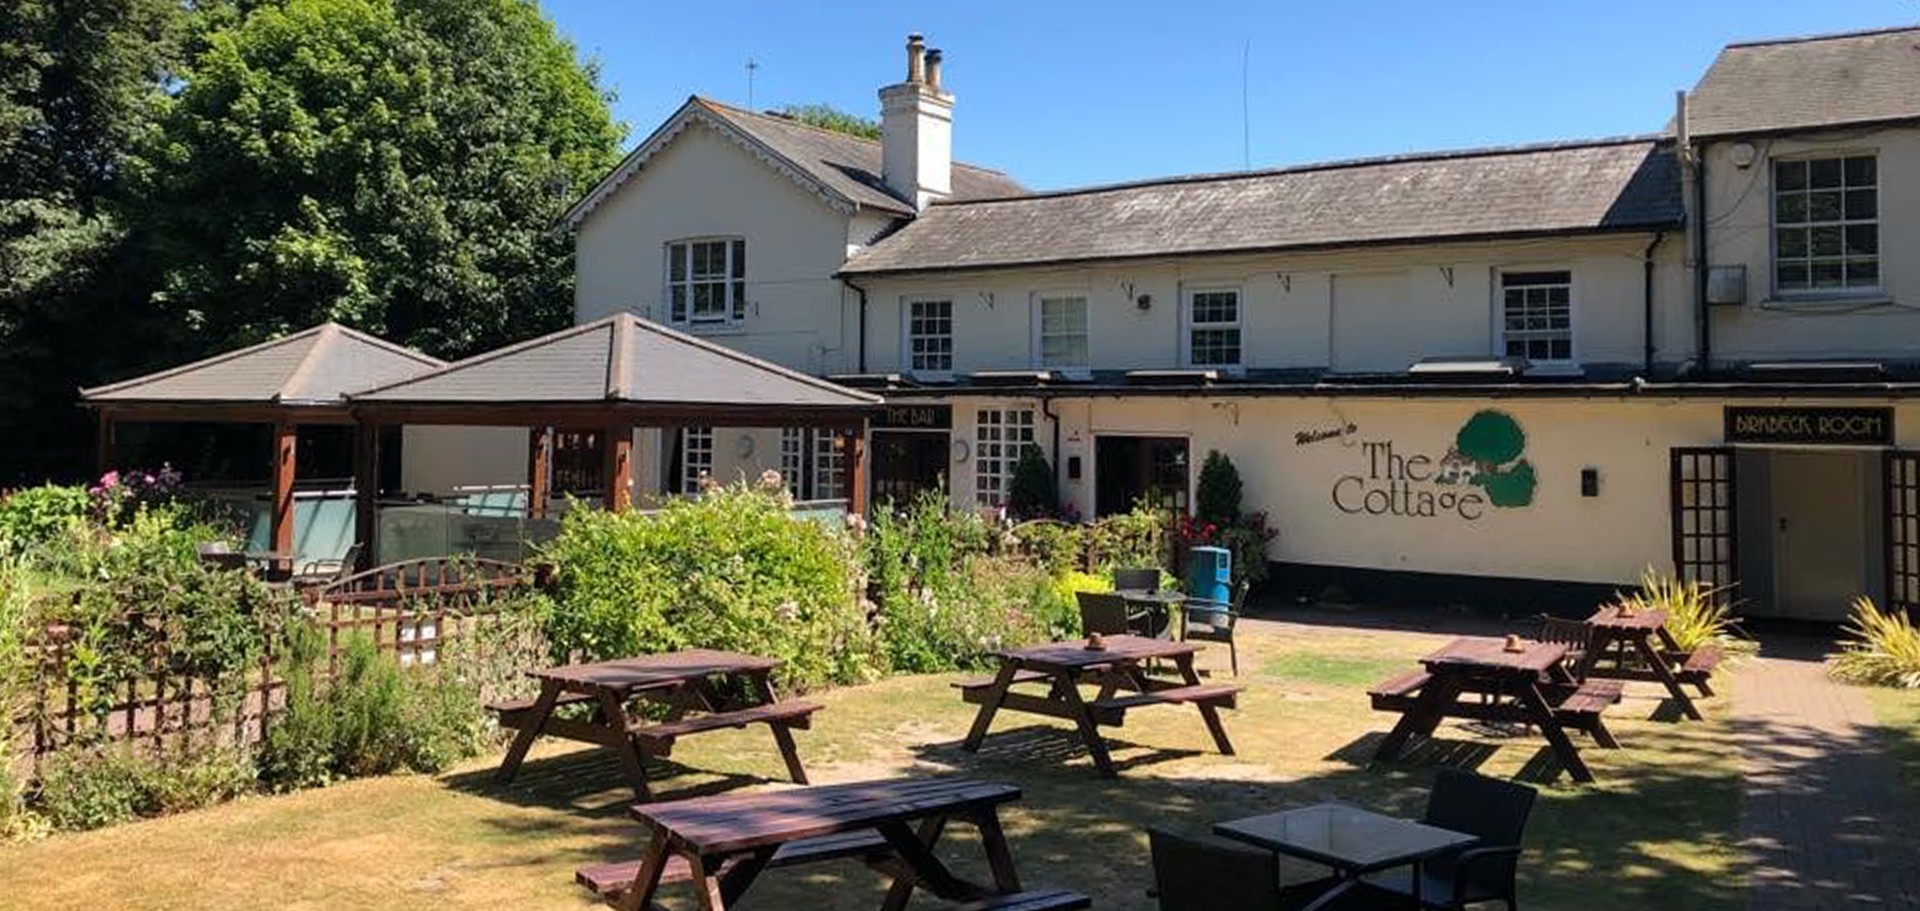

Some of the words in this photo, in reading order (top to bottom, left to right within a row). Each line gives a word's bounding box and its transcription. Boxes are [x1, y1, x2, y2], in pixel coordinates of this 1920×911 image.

[1294, 429, 1342, 446] Welcome
[1346, 423, 1358, 435] to
[1736, 415, 1812, 435] BIRKBECK
[1819, 416, 1882, 435] ROOM
[1362, 440, 1432, 482] The
[1332, 476, 1484, 520] Cottage
